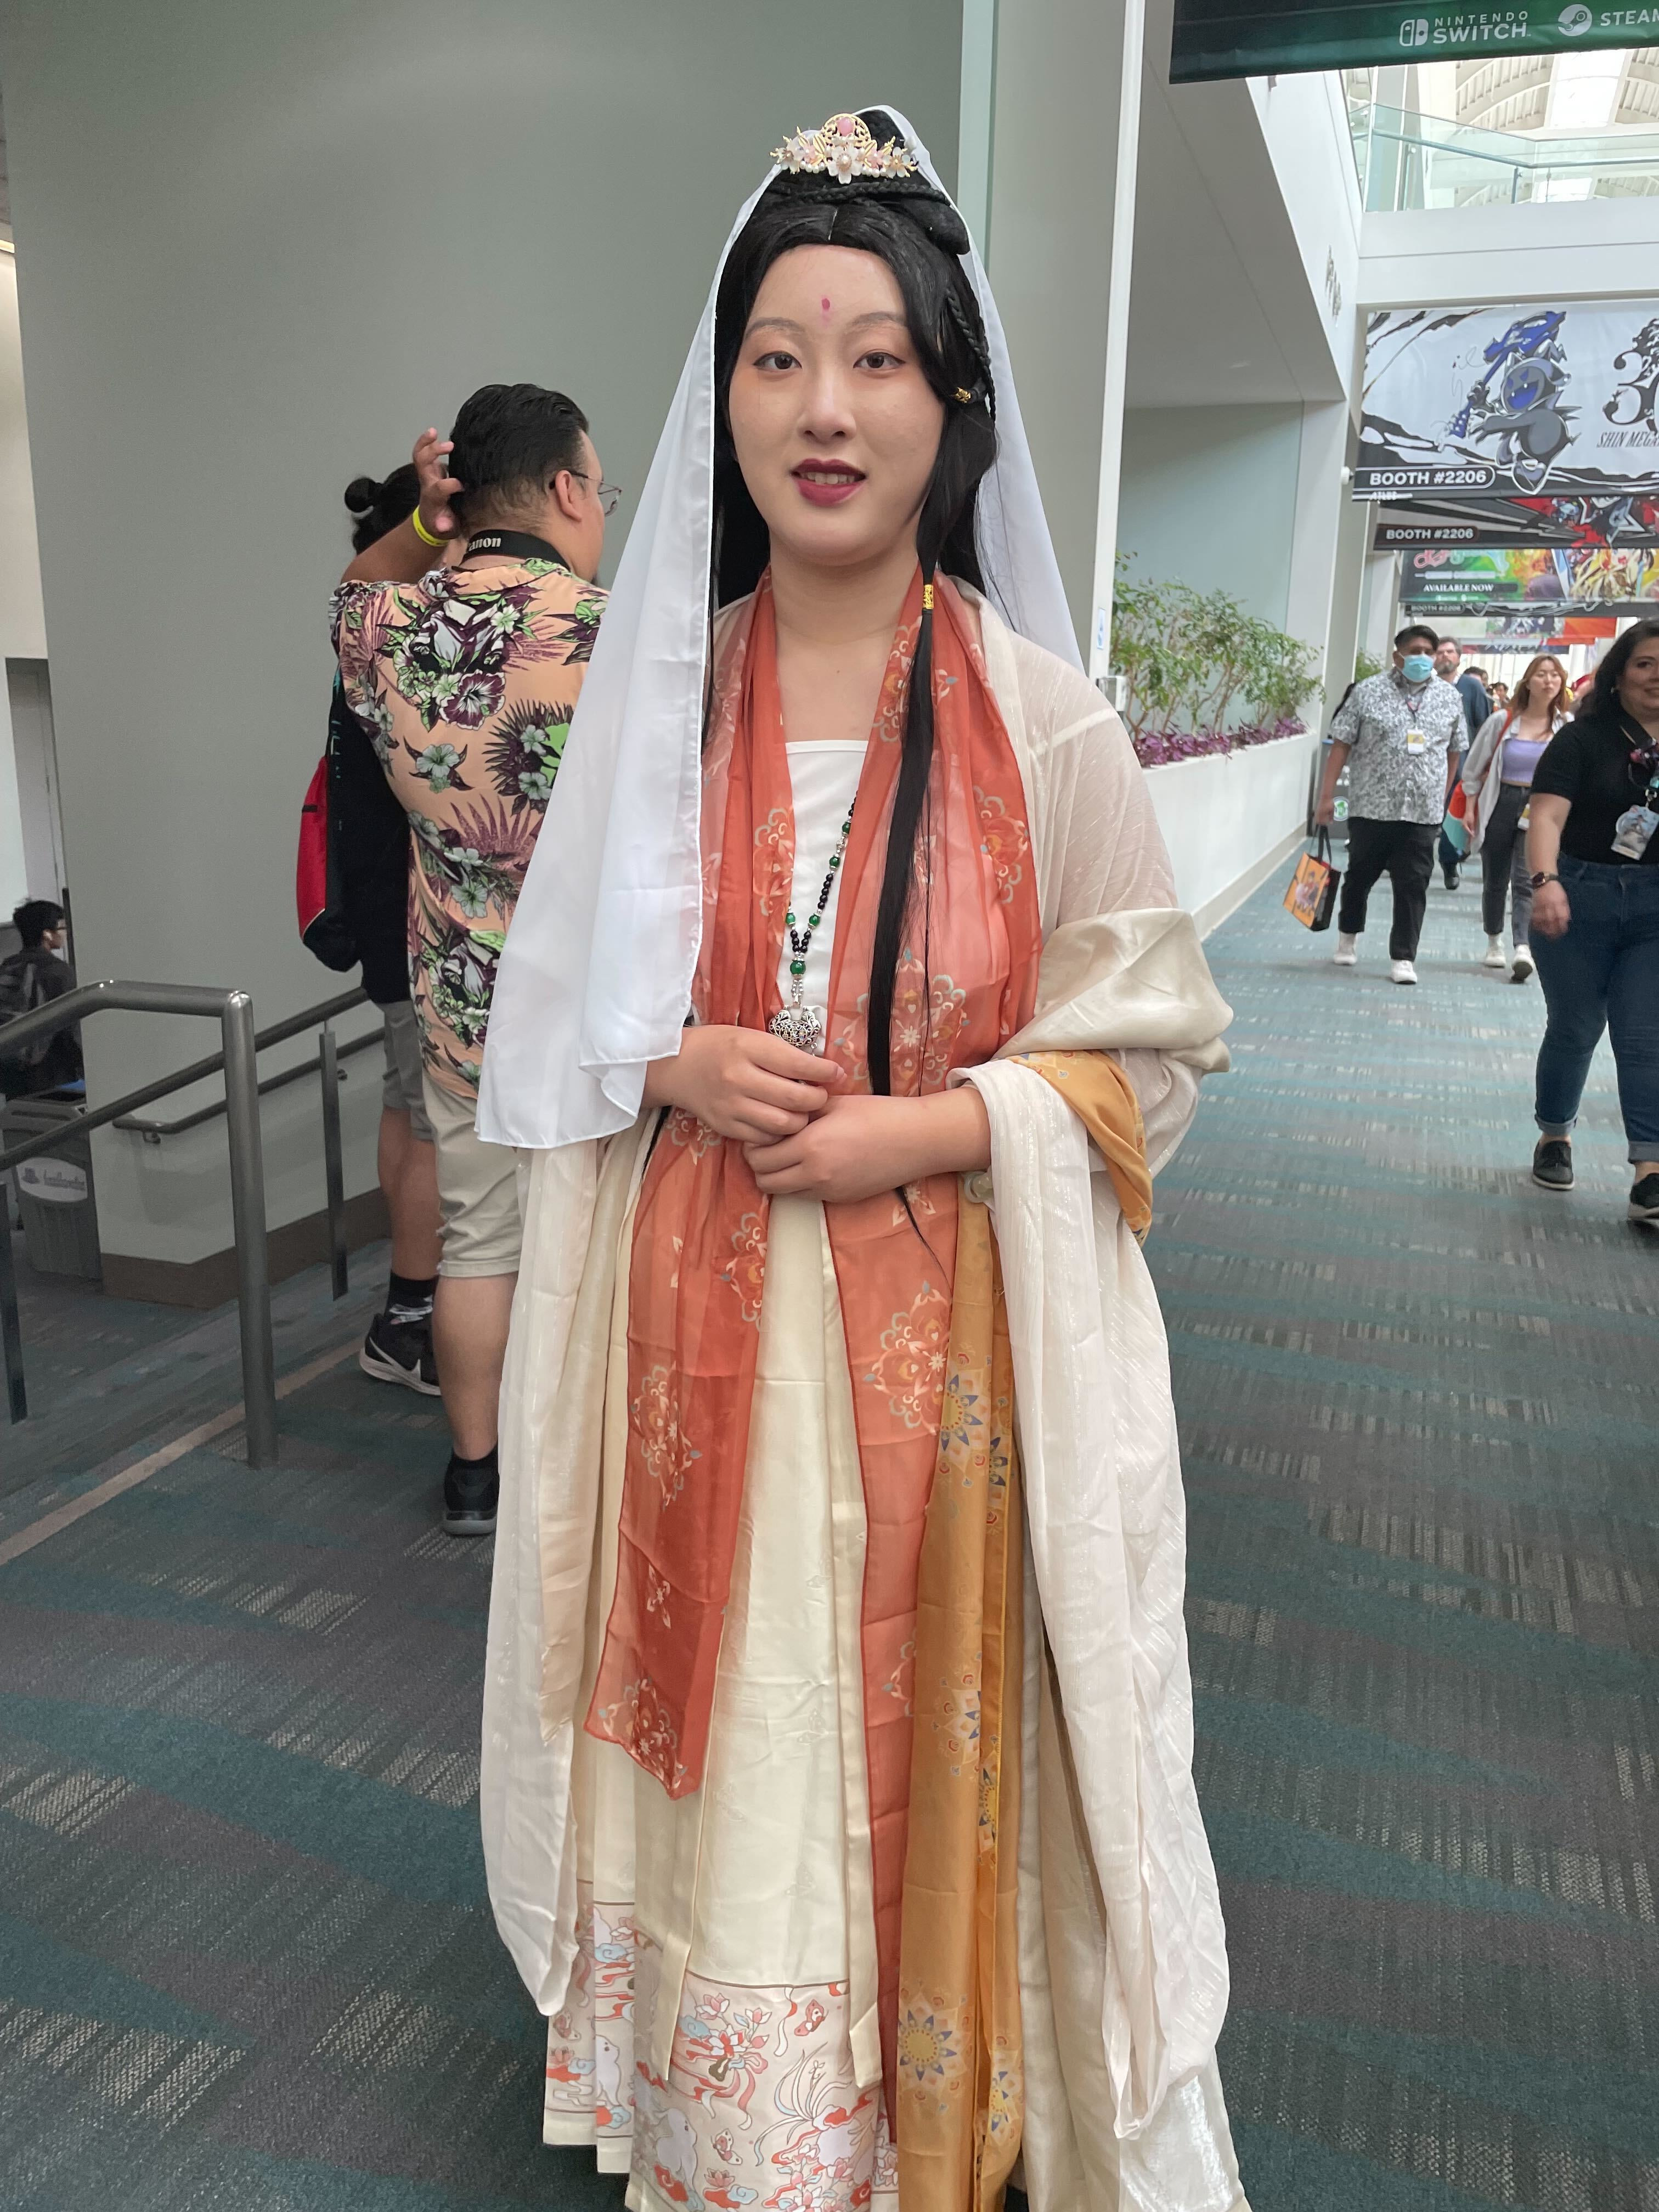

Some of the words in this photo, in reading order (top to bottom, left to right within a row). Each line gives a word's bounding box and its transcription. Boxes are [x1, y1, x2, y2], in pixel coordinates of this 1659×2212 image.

[1435, 11, 1528, 27] NINTENDO
[1433, 22, 1527, 44] SWITCH
[1596, 431, 1628, 448] SHIN
[1625, 431, 1659, 448] MEGA
[1370, 471, 1430, 486] BOOTH
[1434, 470, 1487, 484] #2206
[1386, 529, 1431, 540] BOOTH
[1434, 528, 1474, 539] #2206
[1423, 584, 1470, 592] AVAILABLE
[1471, 584, 1494, 592] NOW
